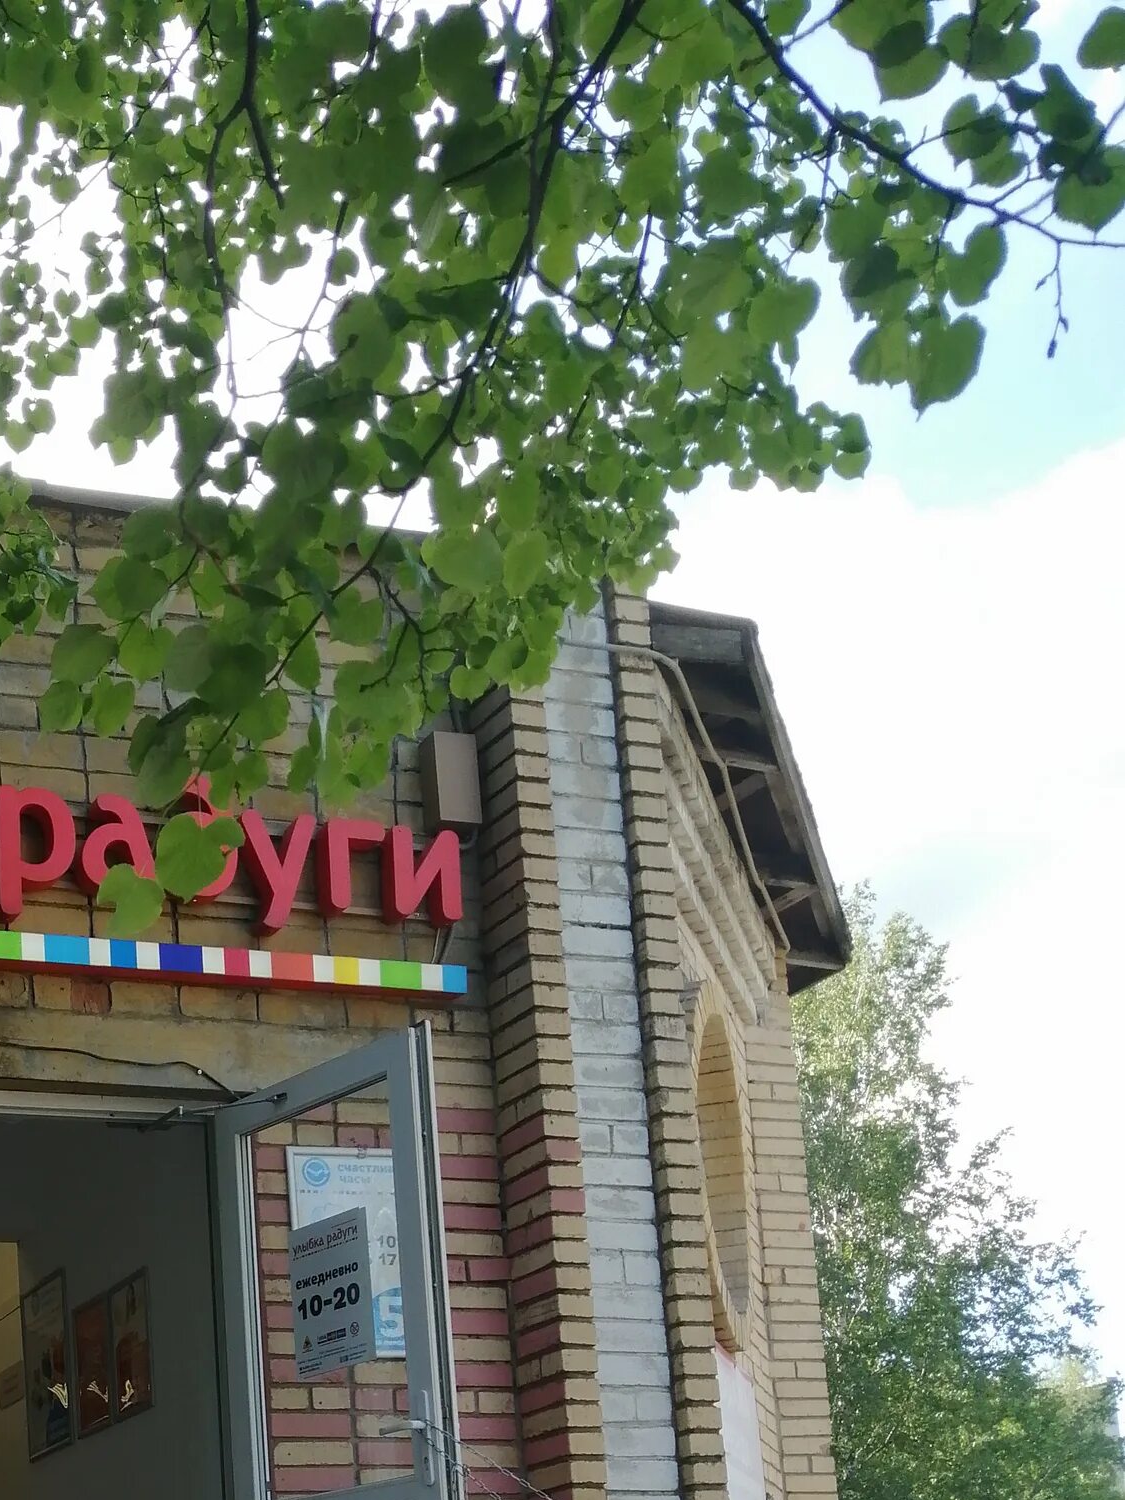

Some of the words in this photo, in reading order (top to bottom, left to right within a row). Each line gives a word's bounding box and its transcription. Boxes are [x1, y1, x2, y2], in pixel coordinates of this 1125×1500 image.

[292, 1236, 325, 1257] улыбка
[326, 1225, 358, 1248] радуги
[295, 1262, 359, 1290] ежедневно
[297, 1283, 360, 1320] 10-20
